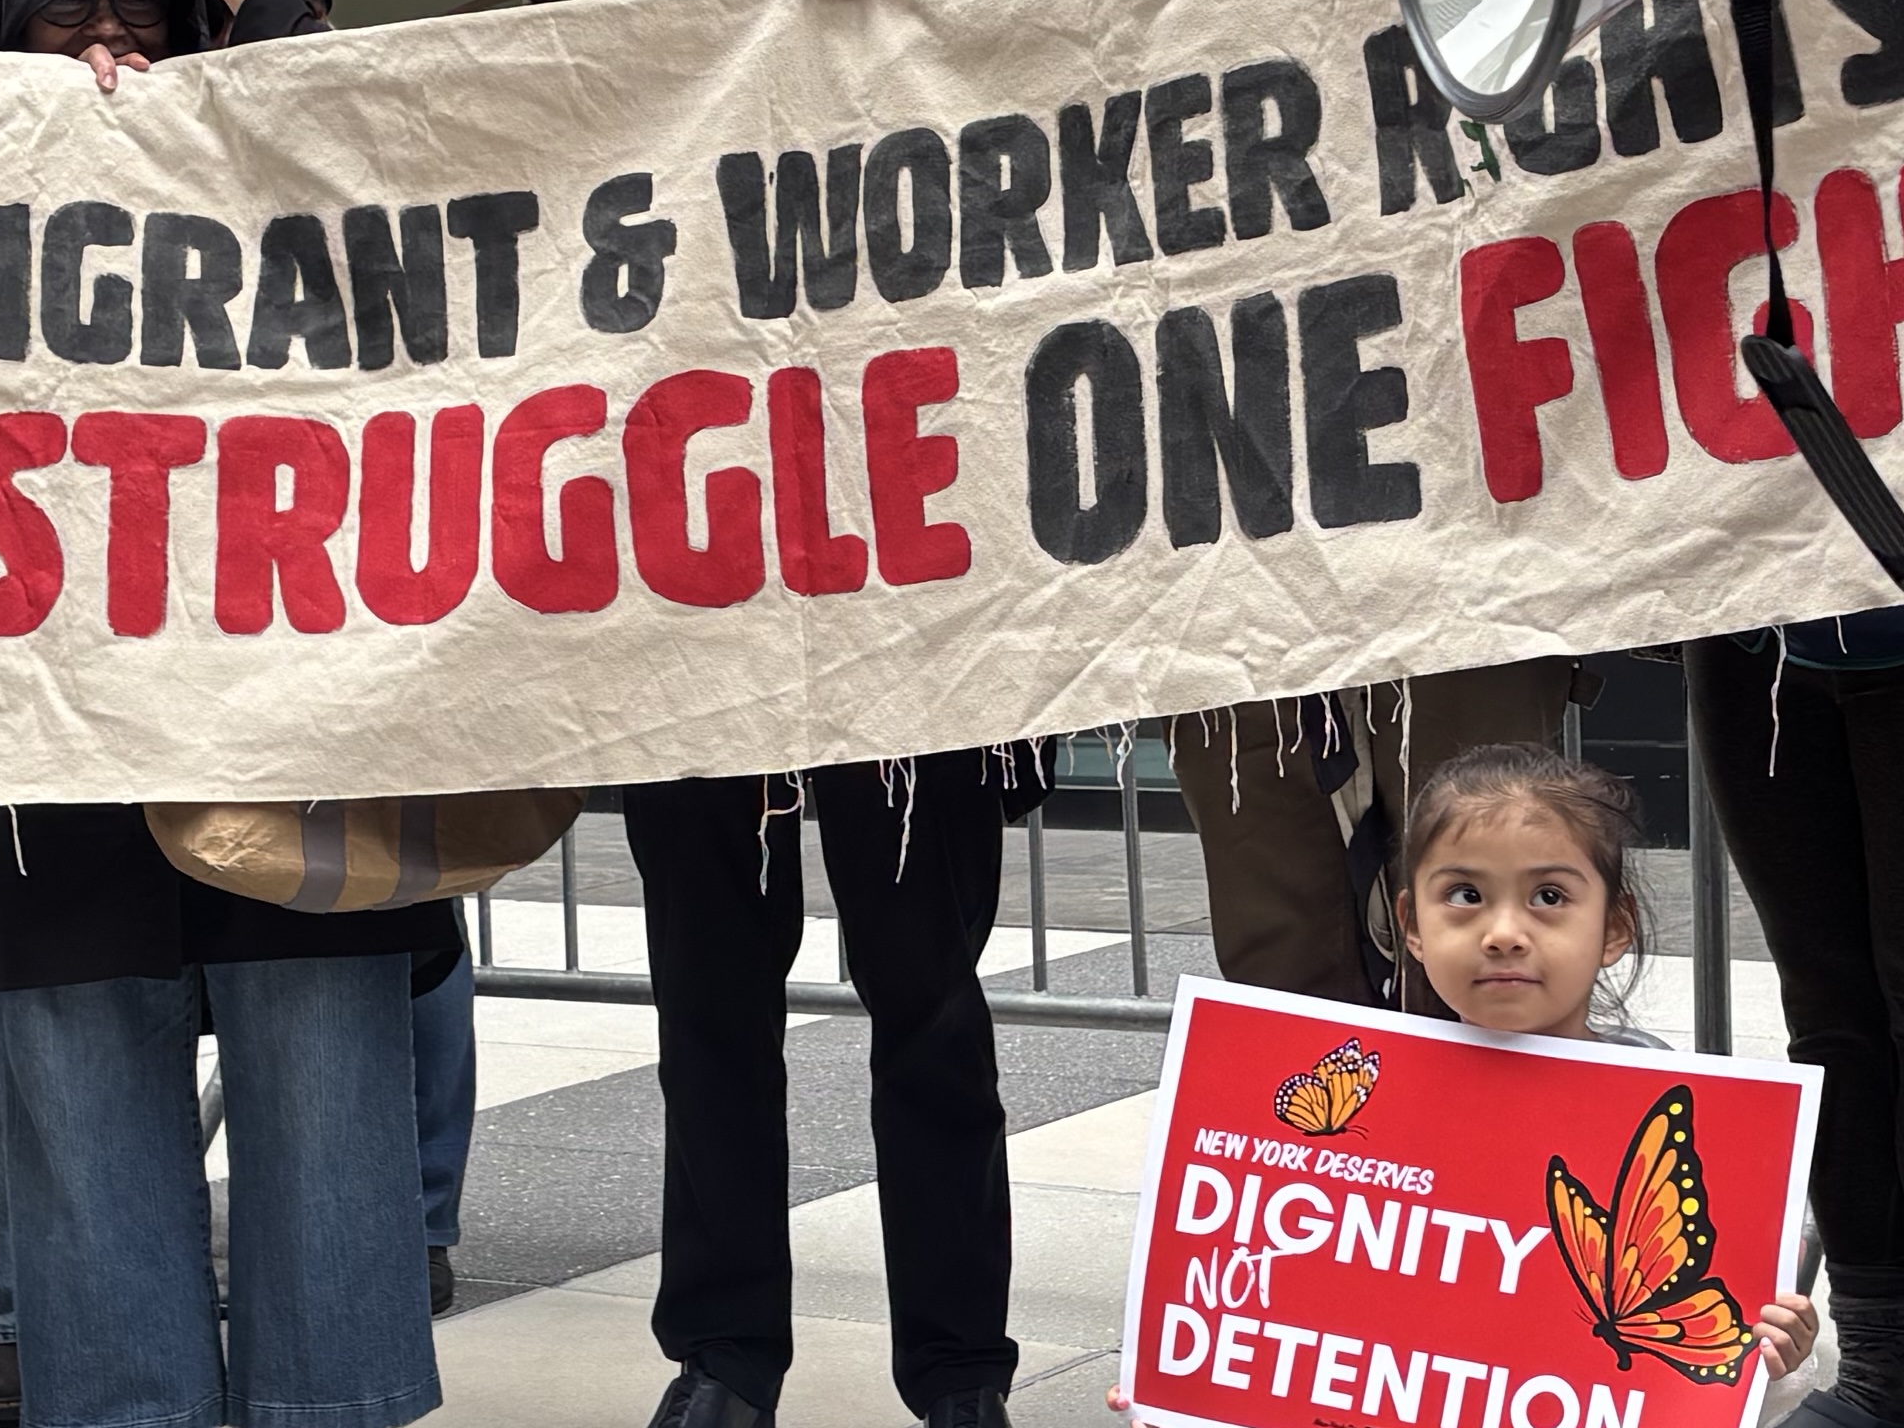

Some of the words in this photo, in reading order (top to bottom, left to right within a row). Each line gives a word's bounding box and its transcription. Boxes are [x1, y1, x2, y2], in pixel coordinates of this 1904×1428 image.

[579, 172, 677, 334] &
[717, 58, 1323, 320] WORKER
[1025, 273, 1423, 566] ONE
[1194, 1127, 1246, 1157] NEW
[1251, 1137, 1309, 1172] YORK
[1314, 1149, 1435, 1196] DESERVES
[1176, 1163, 1552, 1295] DIGNITY
[1184, 1246, 1281, 1312] NOT
